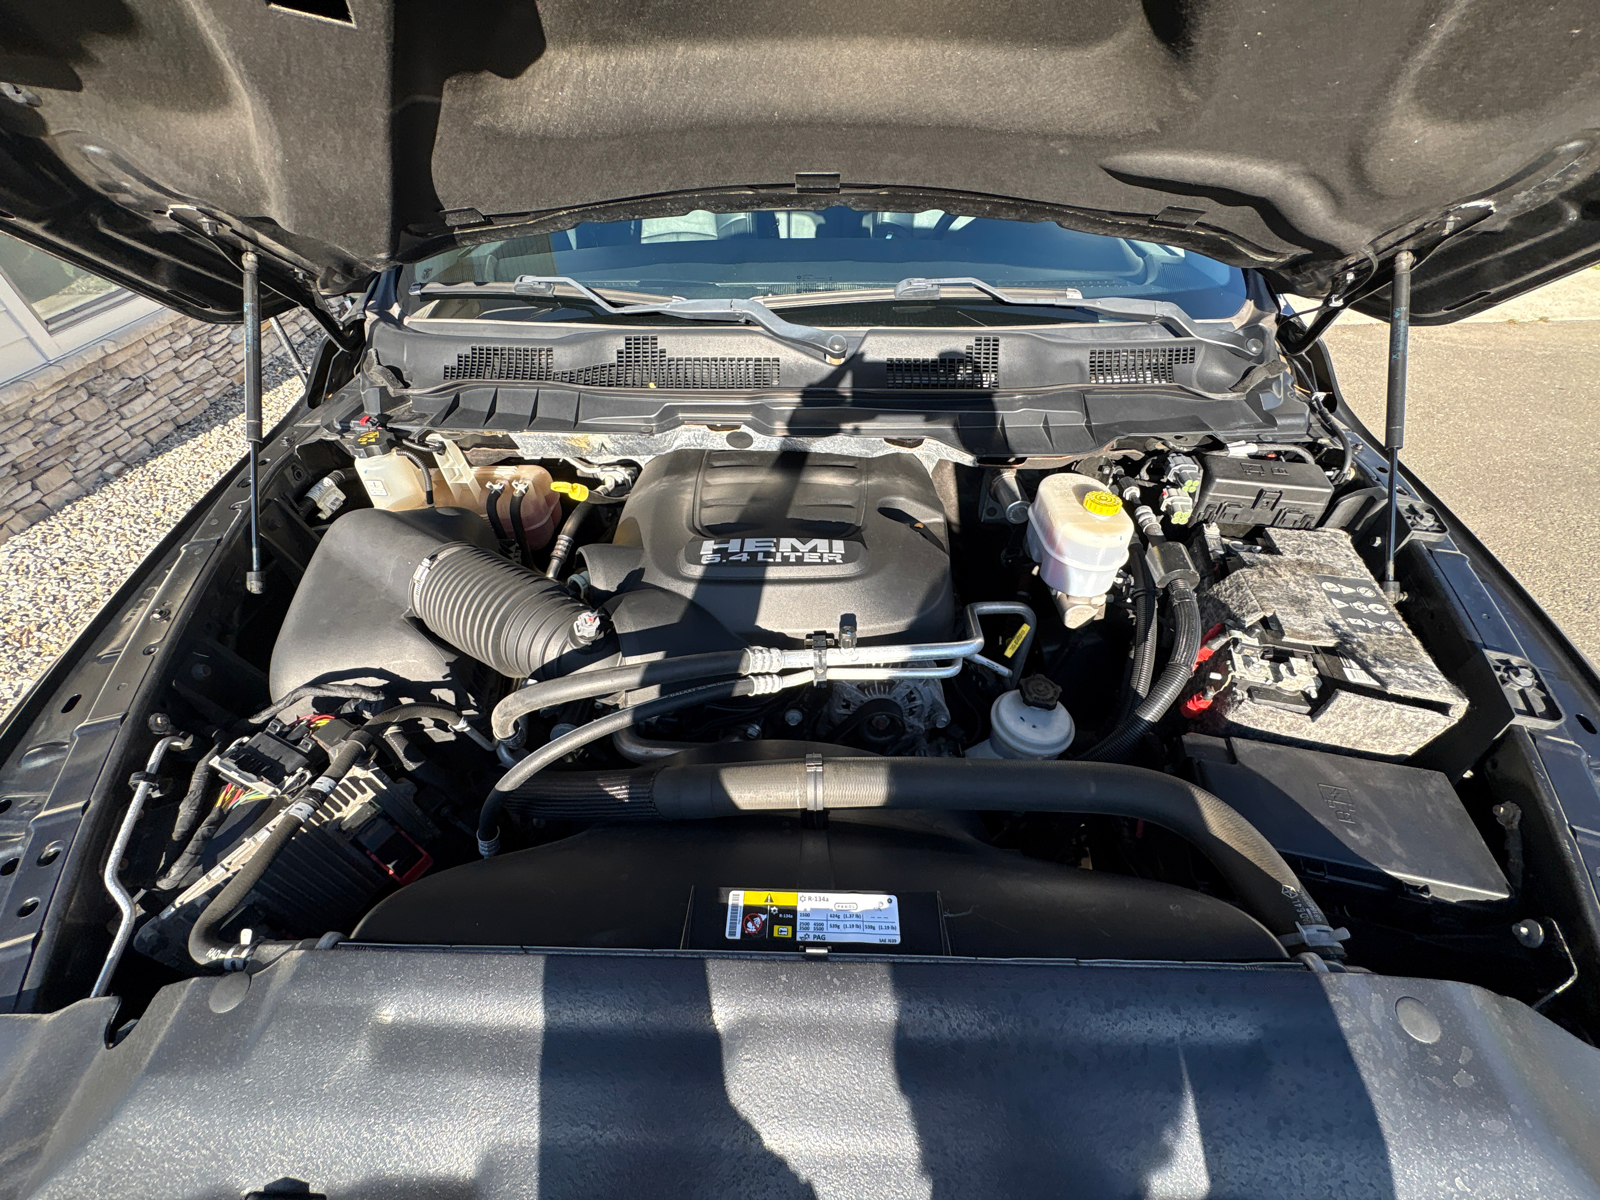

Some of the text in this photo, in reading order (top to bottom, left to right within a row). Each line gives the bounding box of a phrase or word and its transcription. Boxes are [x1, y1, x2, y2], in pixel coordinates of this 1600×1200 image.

[700, 538, 845, 555] HEMI
[700, 552, 844, 564] 6.4 LITER
